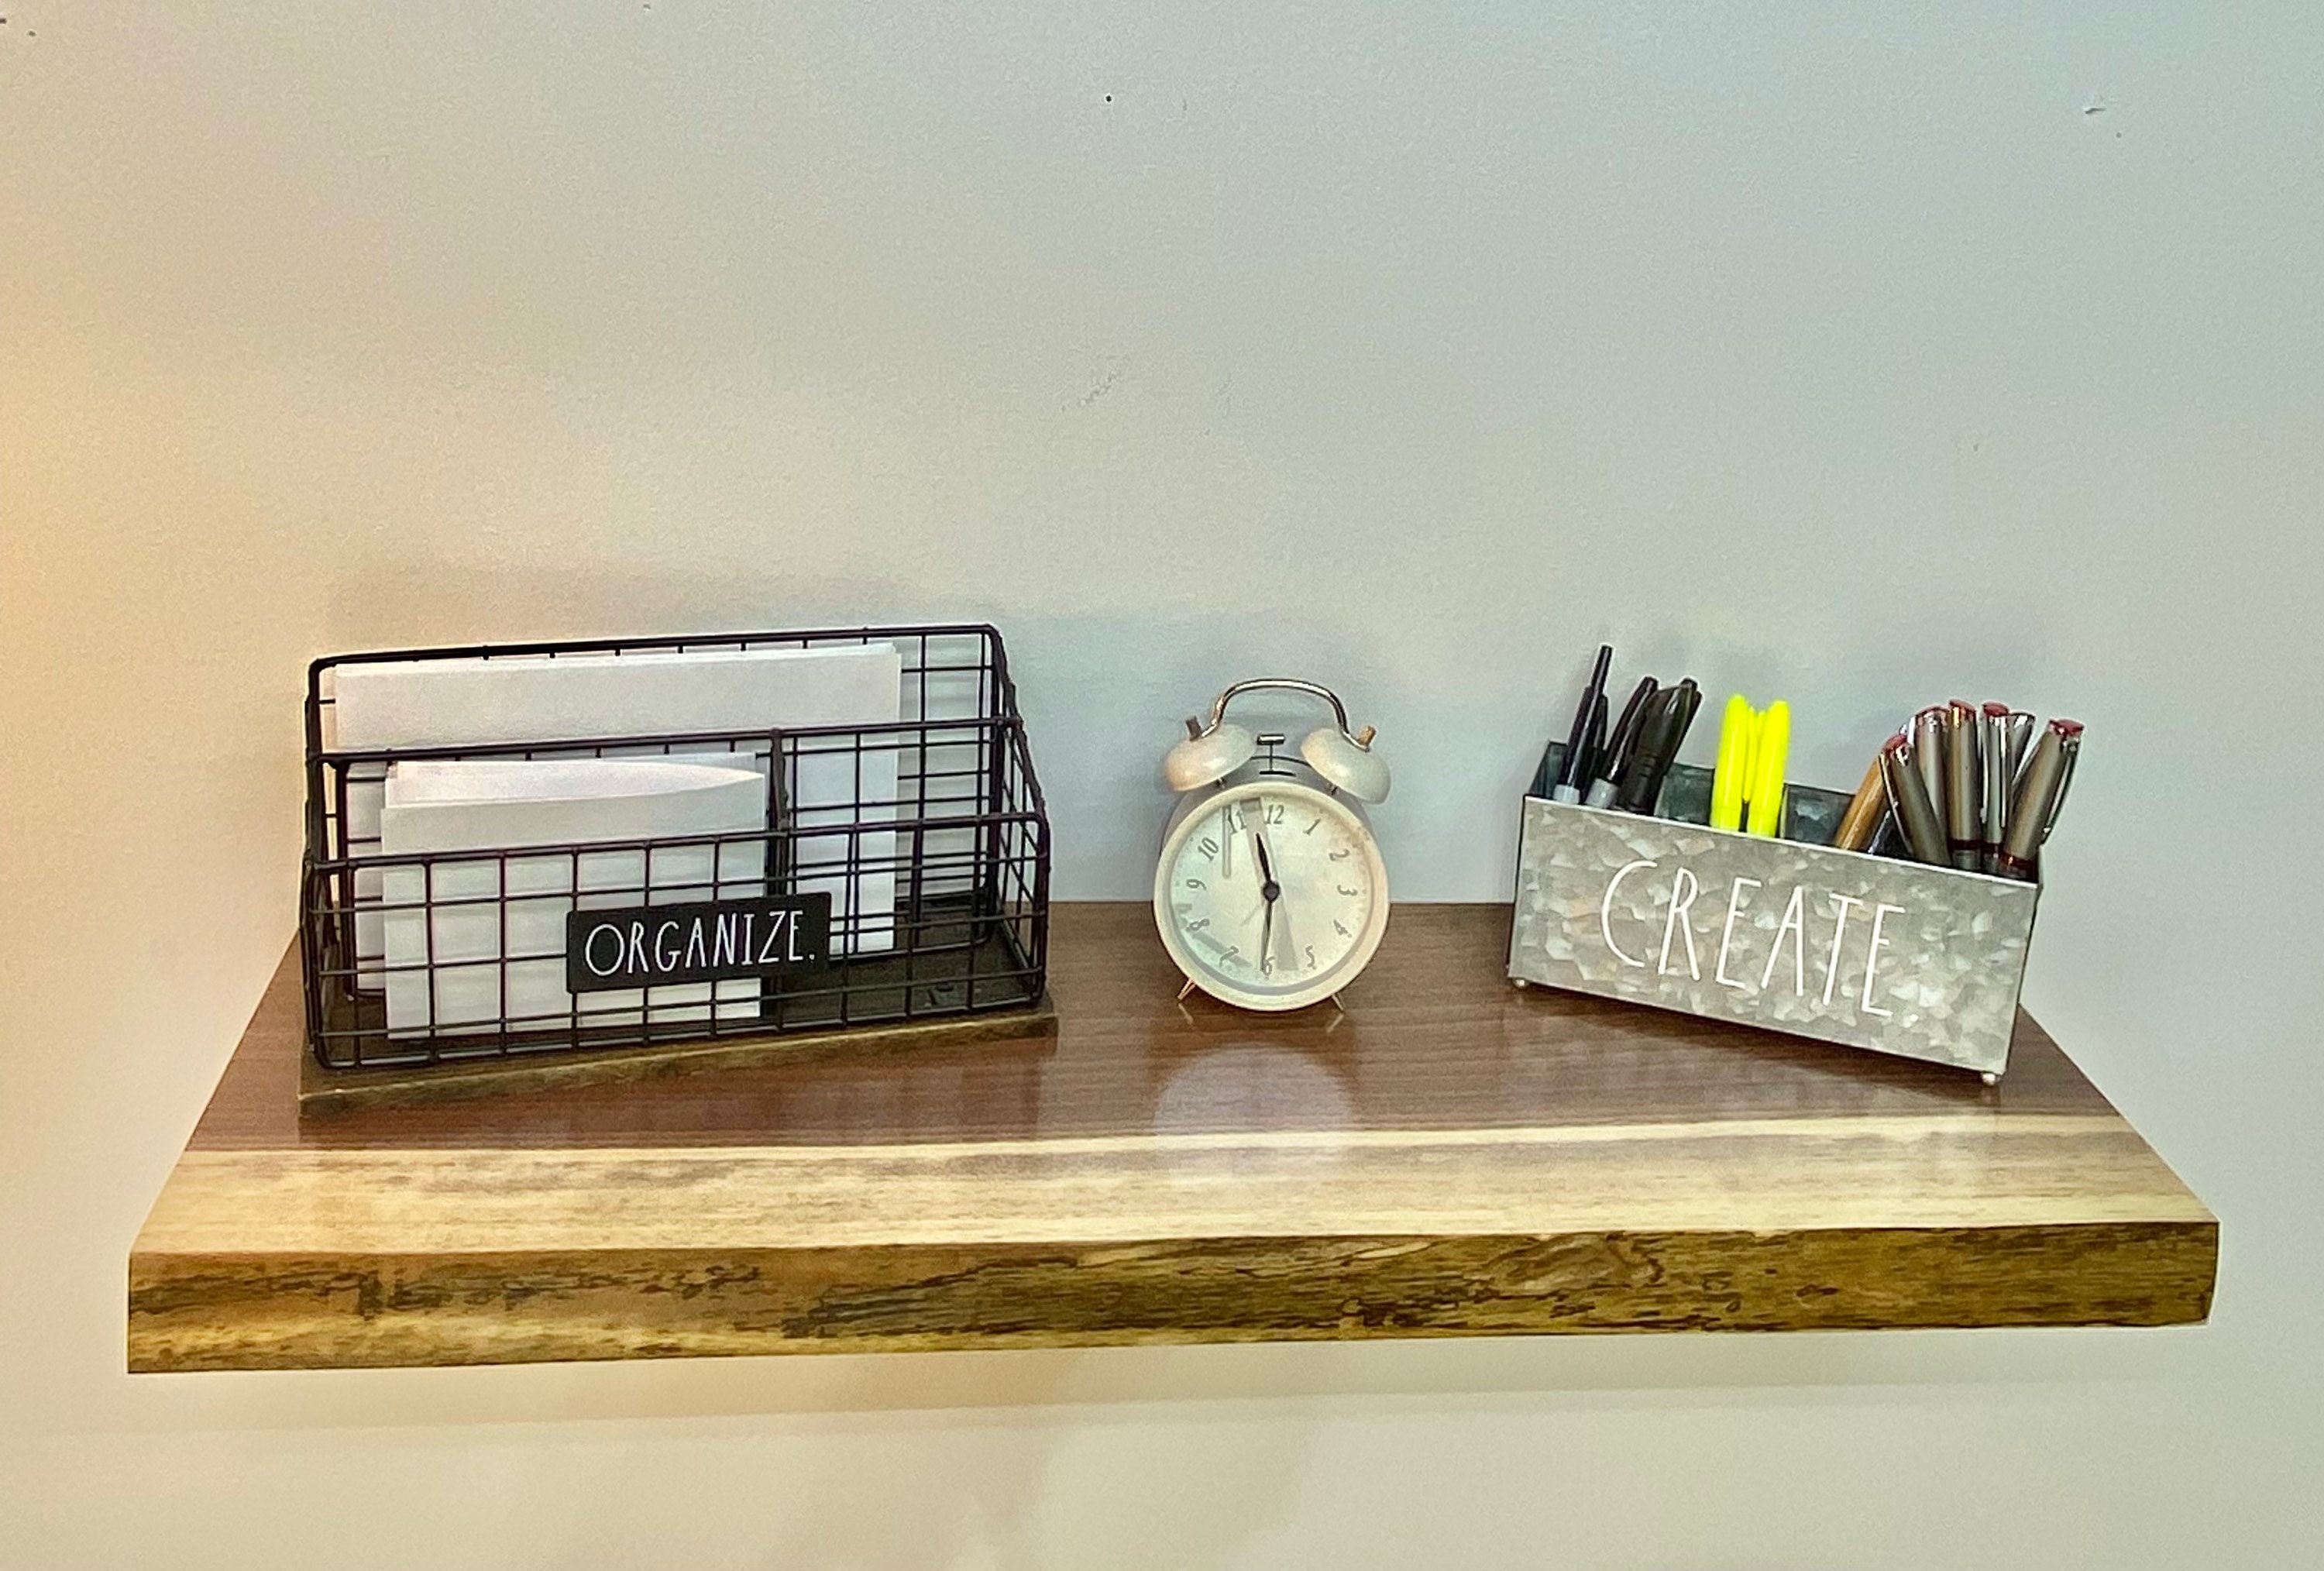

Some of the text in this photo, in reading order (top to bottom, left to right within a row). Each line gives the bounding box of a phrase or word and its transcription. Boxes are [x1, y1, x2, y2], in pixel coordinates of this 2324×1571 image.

[1226, 812, 1247, 835] 11
[1263, 804, 1284, 825] 12
[1303, 818, 1322, 835] 1
[1198, 837, 1219, 862] 10
[1329, 849, 1350, 861] 2
[1186, 878, 1207, 891] 9
[1336, 885, 1357, 896] 3
[1188, 918, 1211, 931] 8
[1332, 920, 1349, 936] 4
[584, 909, 816, 977] ORGANIZE.
[1219, 945, 1239, 968] 7
[1263, 955, 1276, 977] 6
[1305, 944, 1316, 968] 5
